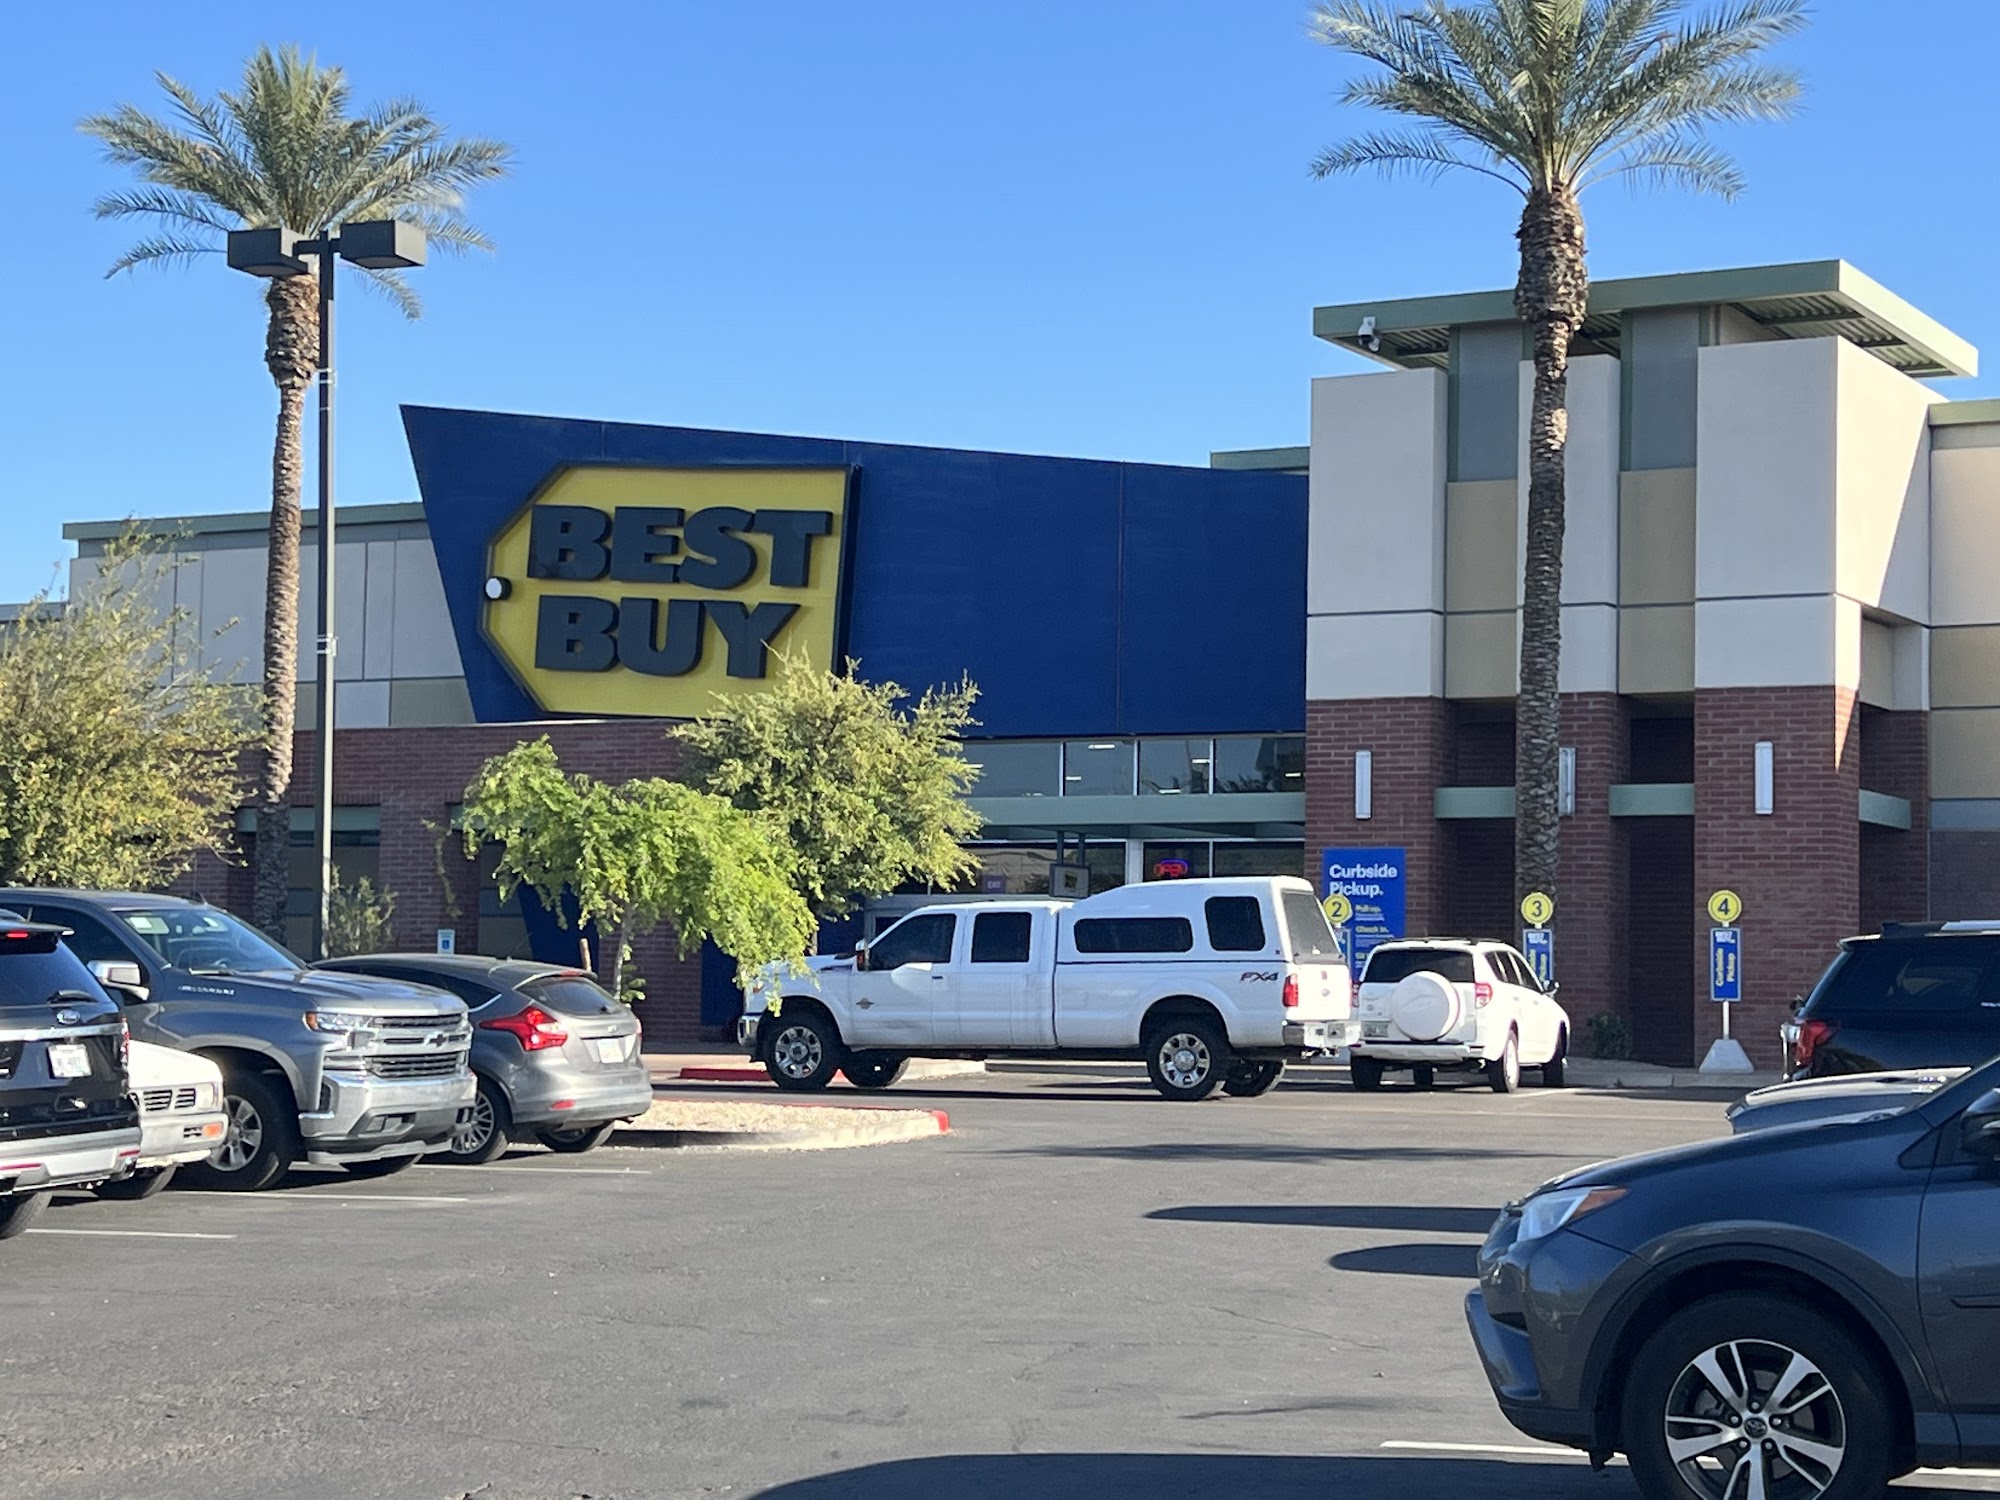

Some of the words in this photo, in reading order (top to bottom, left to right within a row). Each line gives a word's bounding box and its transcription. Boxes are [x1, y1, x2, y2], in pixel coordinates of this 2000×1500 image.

[527, 504, 833, 590] BEST
[534, 594, 801, 679] BUY
[1329, 863, 1398, 878] Curbside
[1329, 881, 1384, 899] Pickup.
[1331, 901, 1342, 917] 2
[1531, 900, 1542, 917] 3
[1717, 897, 1730, 916] 4
[1240, 971, 1279, 982] FX4
